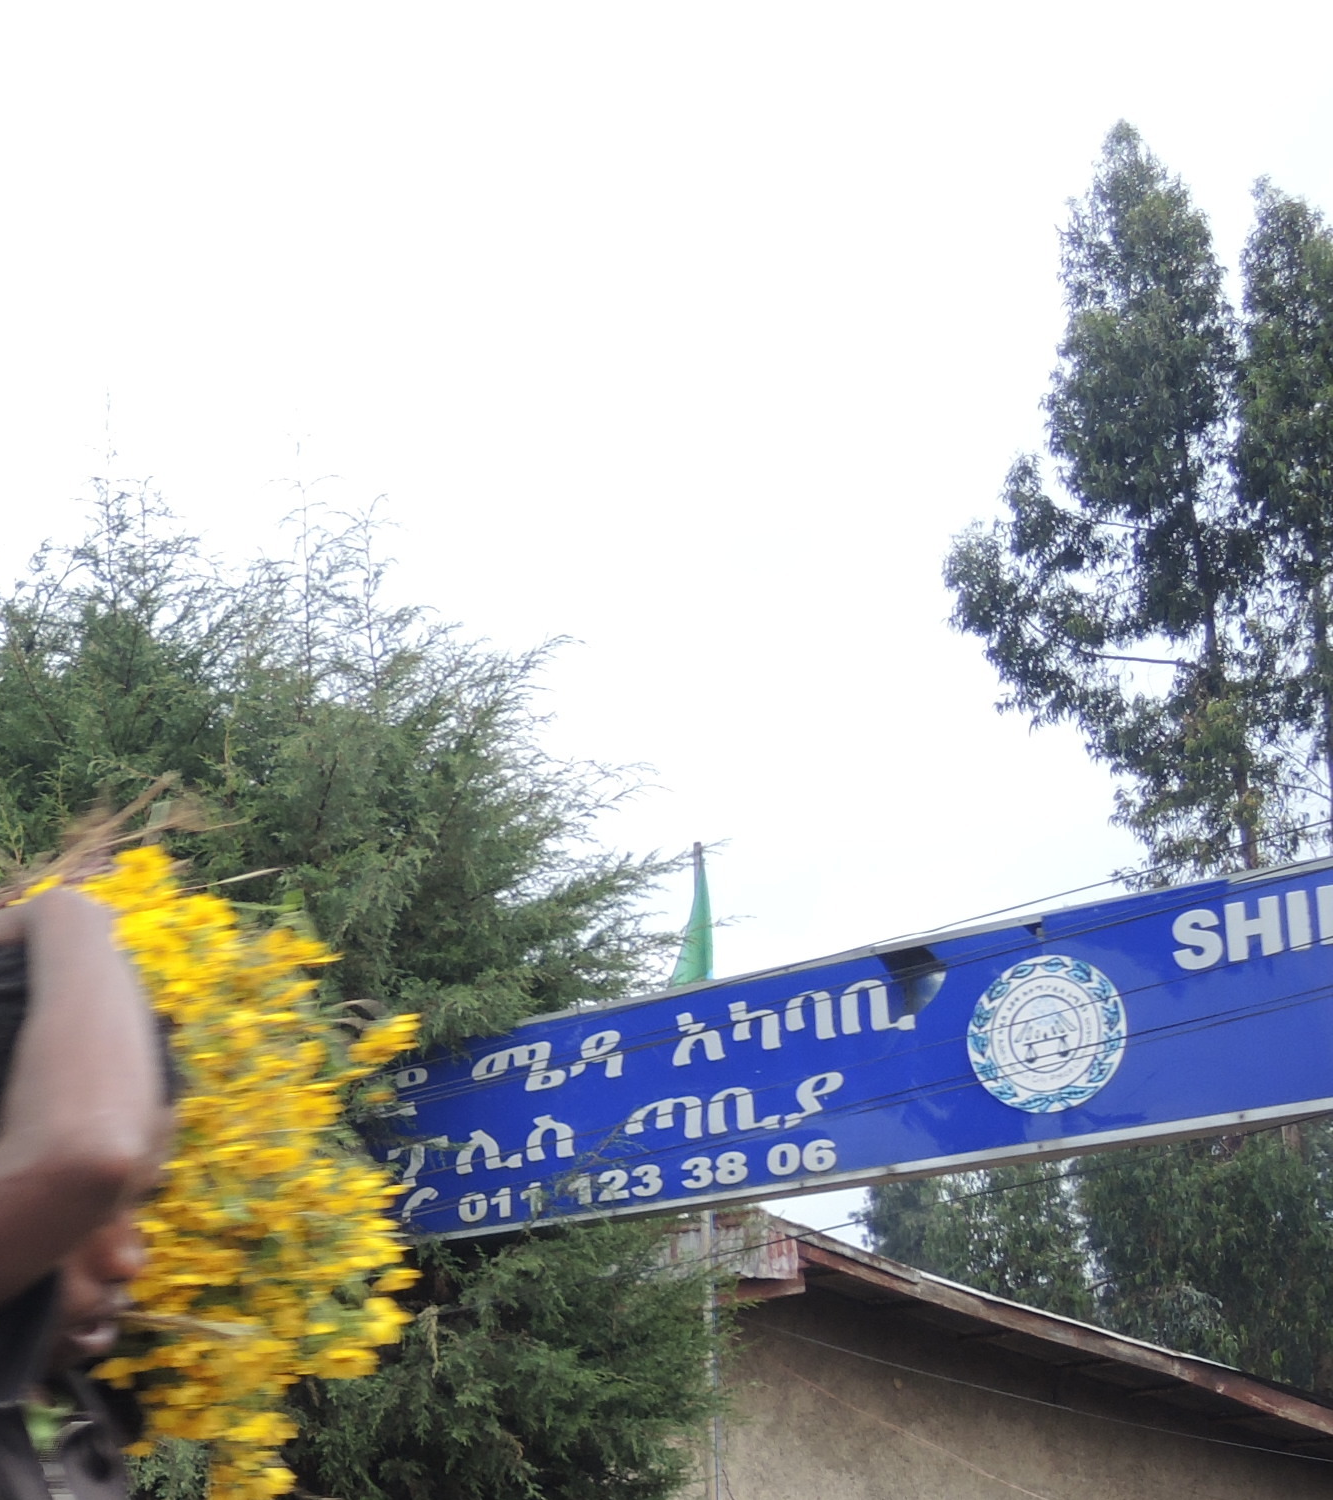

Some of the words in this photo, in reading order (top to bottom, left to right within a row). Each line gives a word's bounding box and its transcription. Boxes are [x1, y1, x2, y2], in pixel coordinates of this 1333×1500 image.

[471, 1029, 623, 1092] ሜዳ
[672, 979, 916, 1067] አካባቢ
[624, 1071, 844, 1139] ጣቢያ
[458, 1182, 542, 1222] 011
[569, 1164, 663, 1204] 123
[681, 1151, 748, 1189] 38
[767, 1139, 837, 1176] 06
